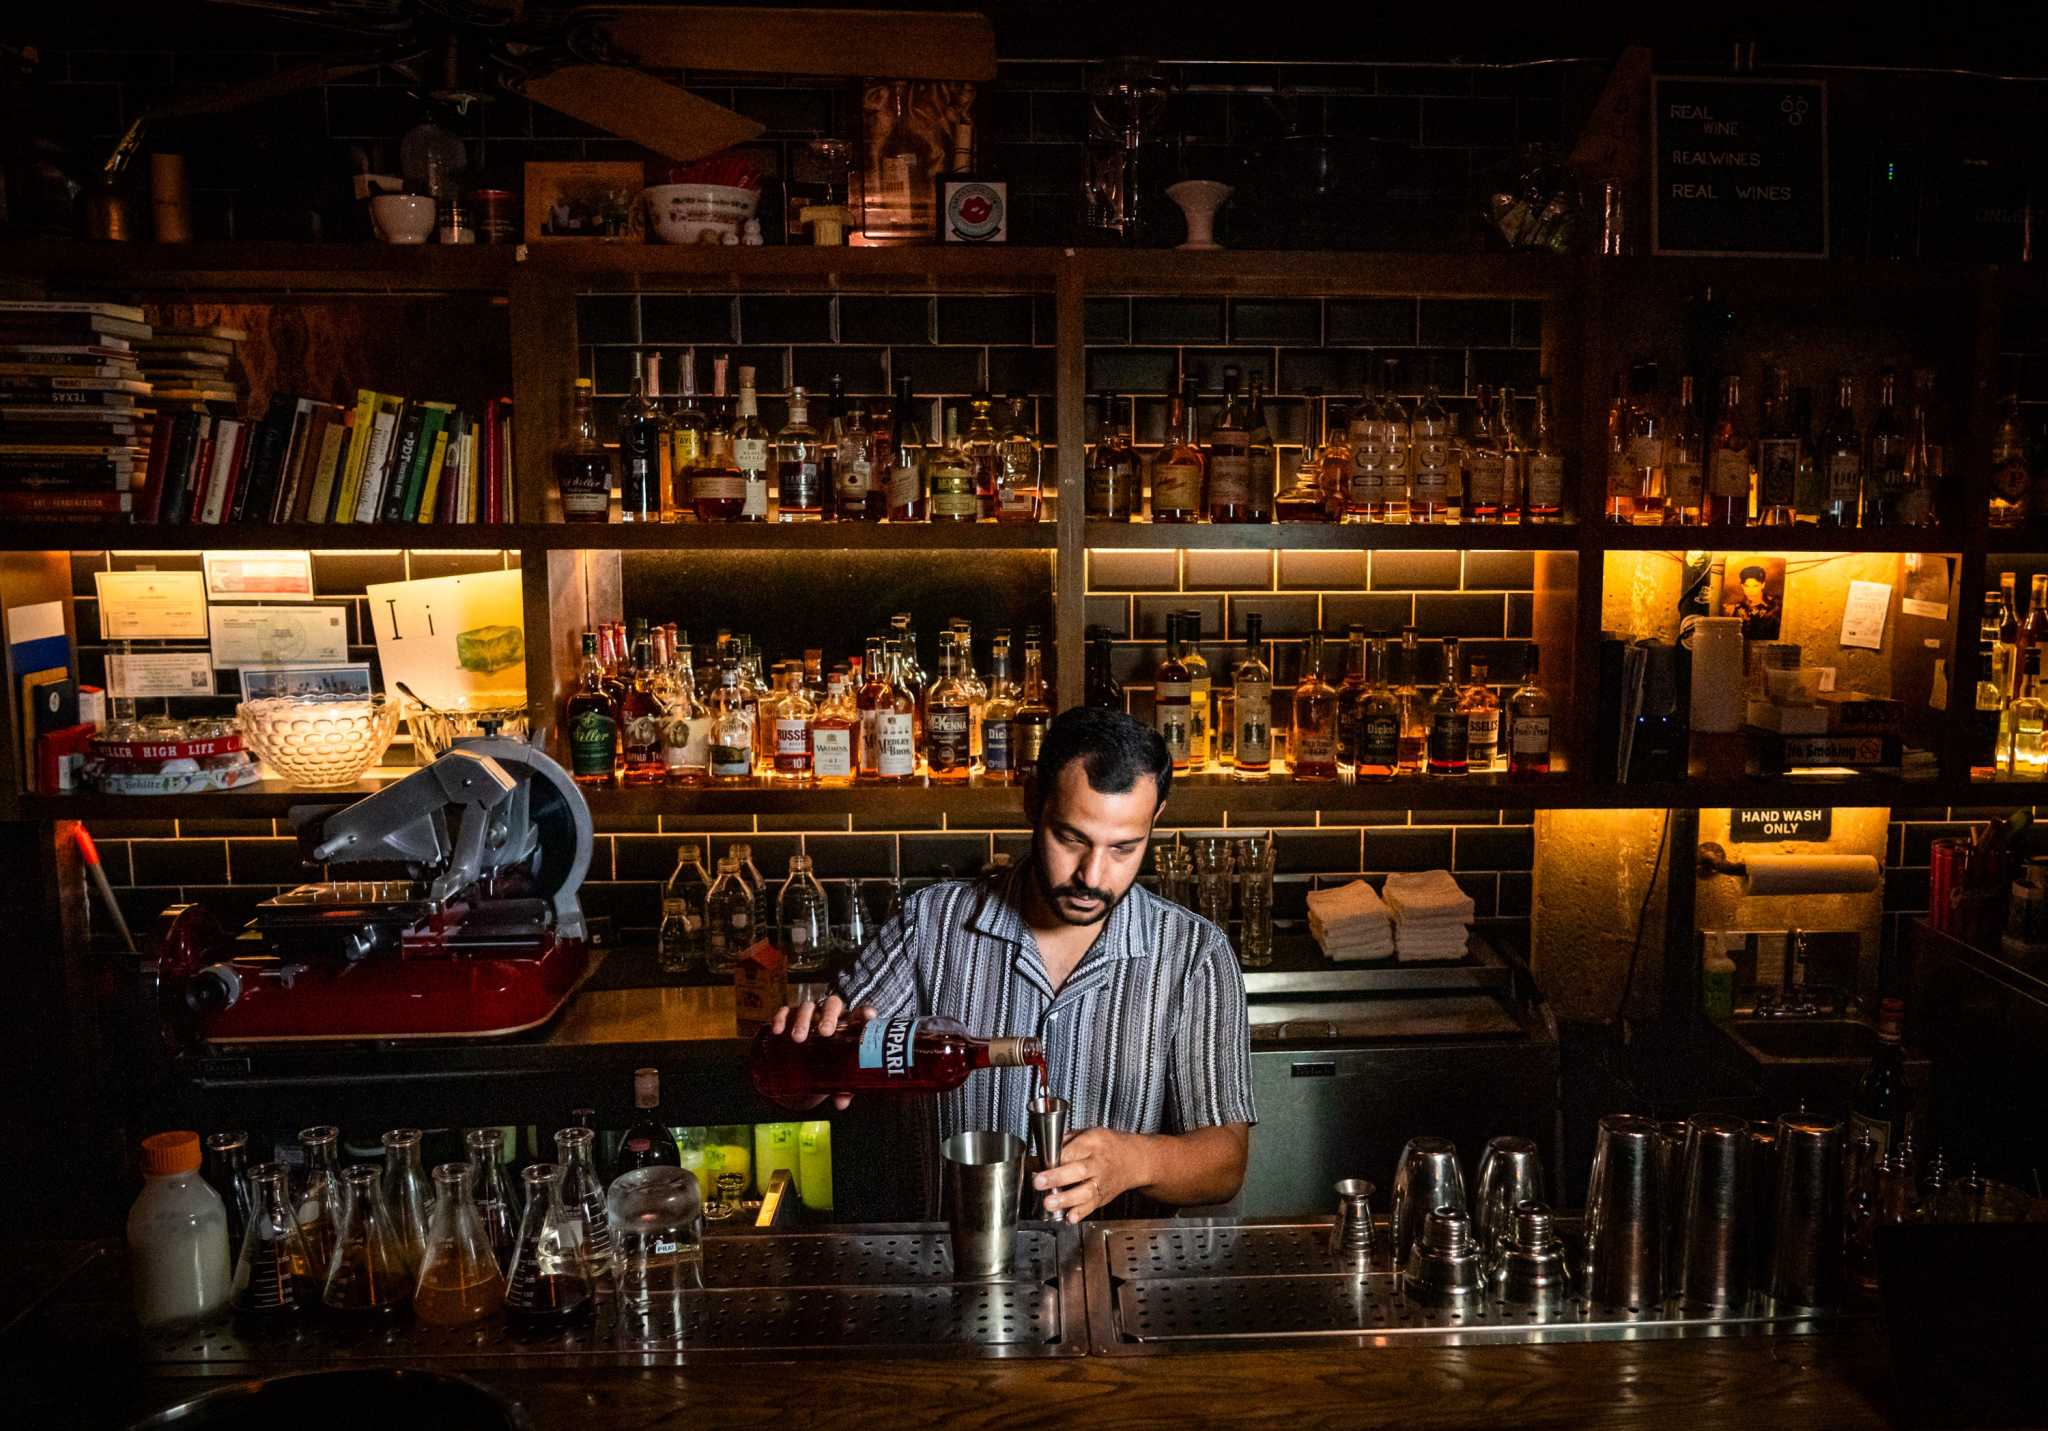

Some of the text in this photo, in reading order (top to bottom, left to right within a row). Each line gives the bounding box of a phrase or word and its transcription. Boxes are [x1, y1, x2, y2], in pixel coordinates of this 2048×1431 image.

[1670, 104, 1713, 120] REAL
[1704, 121, 1739, 137] WINE
[1672, 183, 1793, 201] REAL WINES
[51, 391, 88, 403] TEXAS
[401, 438, 415, 463] PDT
[143, 745, 177, 758] HIGH
[188, 742, 215, 755] LIFE
[1806, 743, 1857, 760] Smoking
[1742, 810, 1822, 822] HAND WASH
[1763, 823, 1799, 834] ONLY
